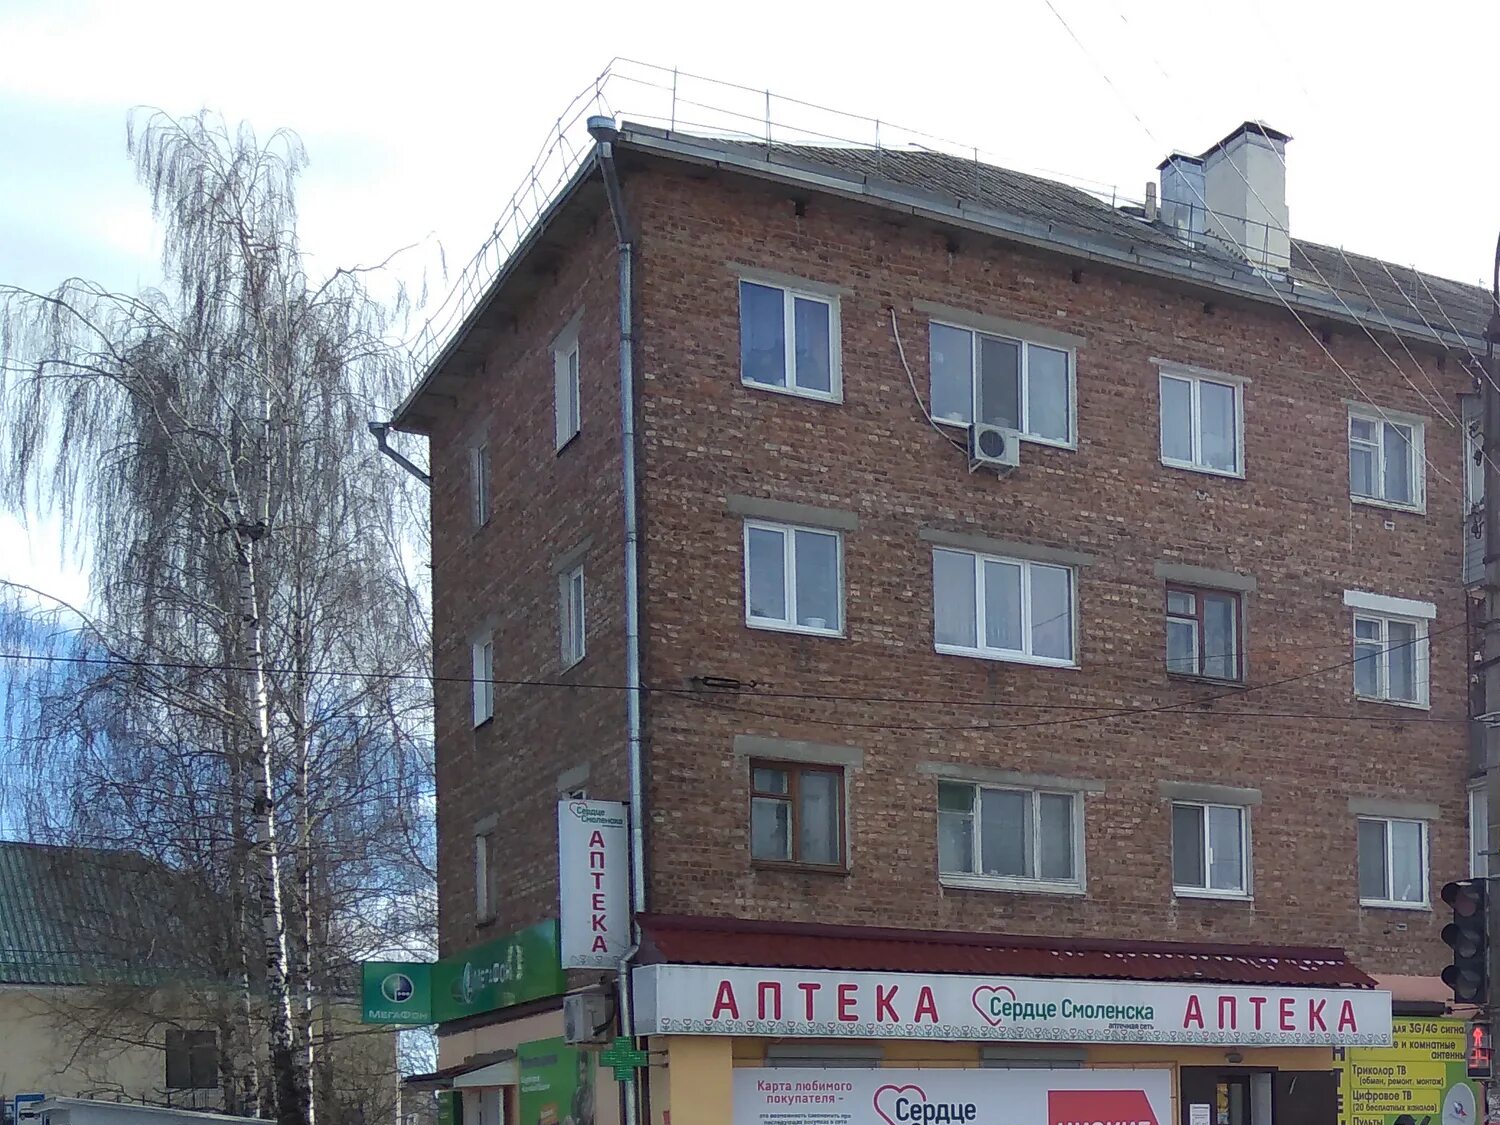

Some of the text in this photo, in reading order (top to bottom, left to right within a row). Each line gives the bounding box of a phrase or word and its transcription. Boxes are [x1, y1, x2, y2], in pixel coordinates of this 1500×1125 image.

[588, 830, 608, 953] АПТЕКА
[711, 980, 940, 1024] АПТЕКА
[990, 996, 1154, 1021] Сердце Смоленска
[1183, 994, 1358, 1033] АПТЕКА
[1109, 1022, 1138, 1030] аптечная
[1409, 1022, 1438, 1035] 3G/4G
[1440, 1025, 1466, 1034] сигна
[1402, 1041, 1407, 1049] и
[1409, 1040, 1456, 1050] комнатные
[1352, 1064, 1406, 1077] Триколор ТВ
[757, 1080, 853, 1093] Карта любимого
[766, 1094, 835, 1106] покупателя
[1352, 1089, 1412, 1103] Цифровое ТВ
[1352, 1103, 1364, 1113] (20
[1366, 1103, 1406, 1112] бесплатных
